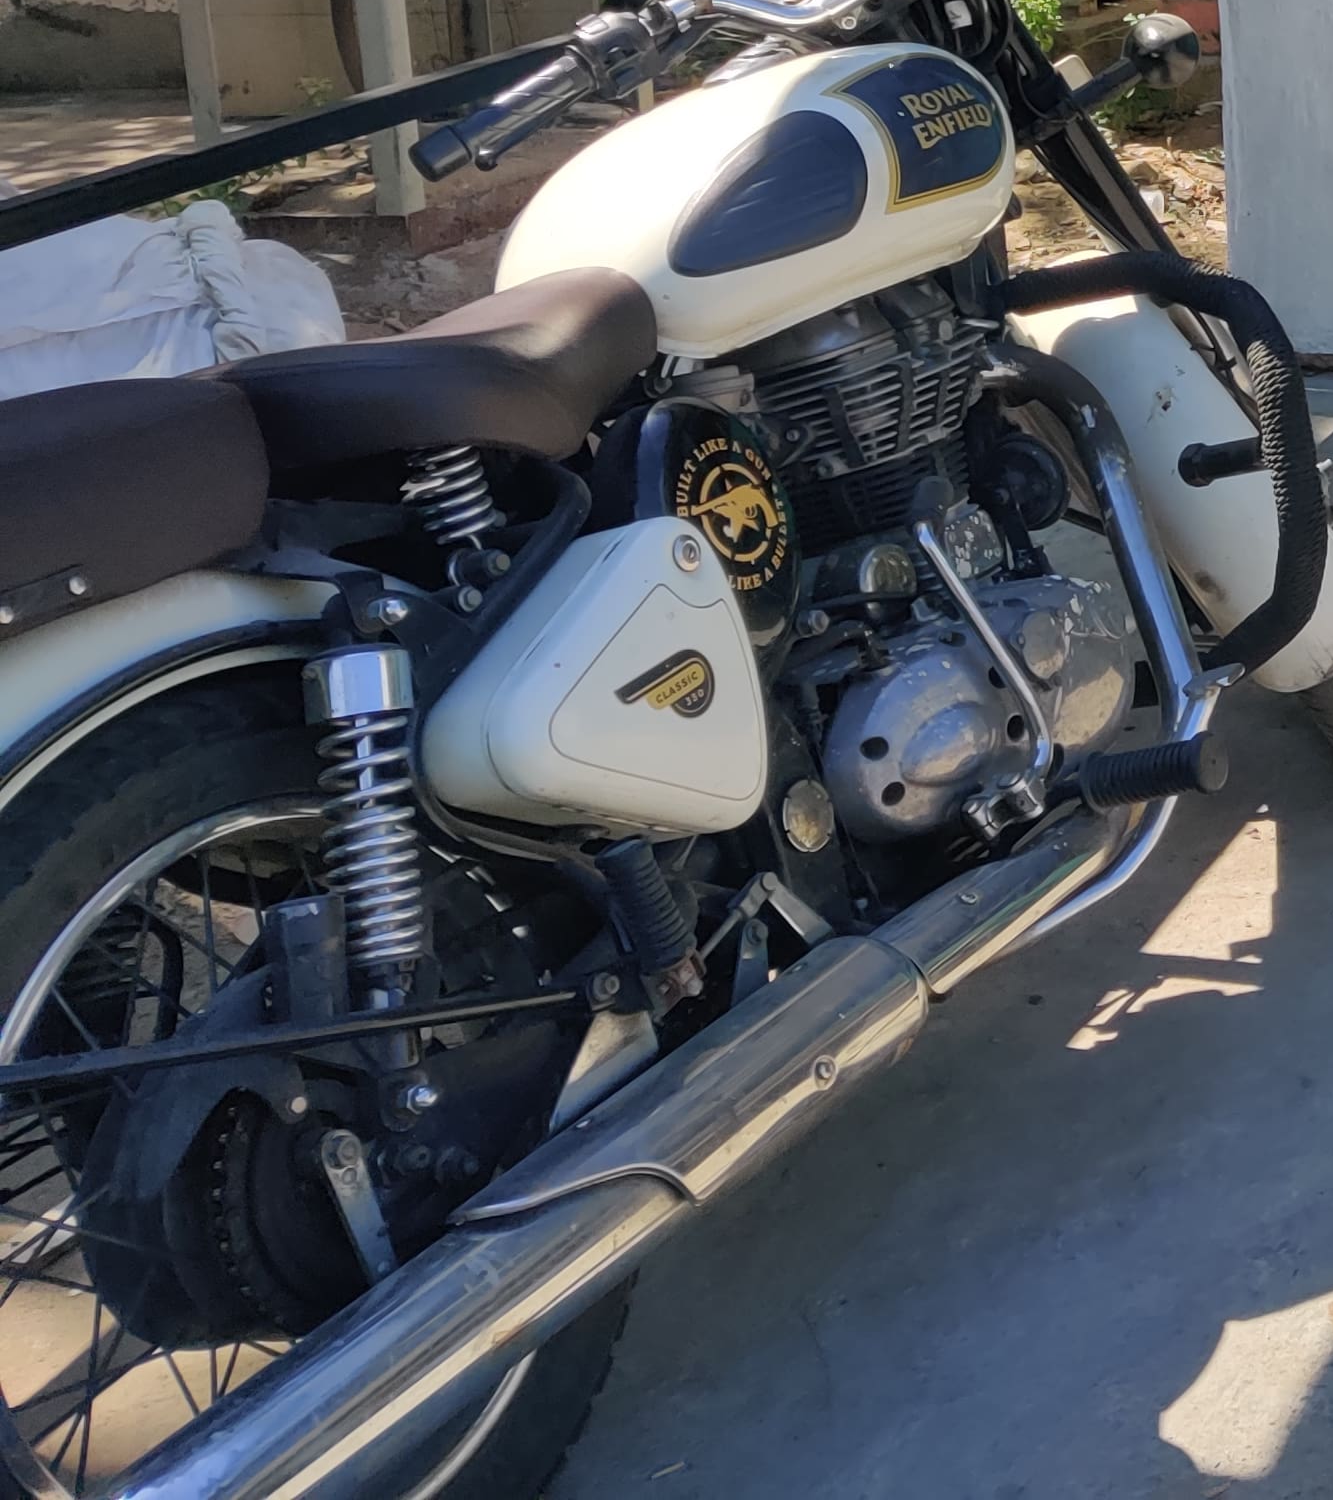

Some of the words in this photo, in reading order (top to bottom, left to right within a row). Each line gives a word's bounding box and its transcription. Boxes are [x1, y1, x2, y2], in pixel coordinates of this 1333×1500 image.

[899, 83, 976, 119] ROYAL
[912, 103, 992, 149] ENFIELD
[676, 459, 697, 518] BUILT
[693, 438, 729, 462] LIKE
[732, 441, 742, 454] A
[745, 448, 772, 480] GUN
[728, 574, 763, 591] LIKE
[764, 567, 774, 581] A
[655, 671, 698, 704] CLASSIC
[685, 688, 705, 706] 350
